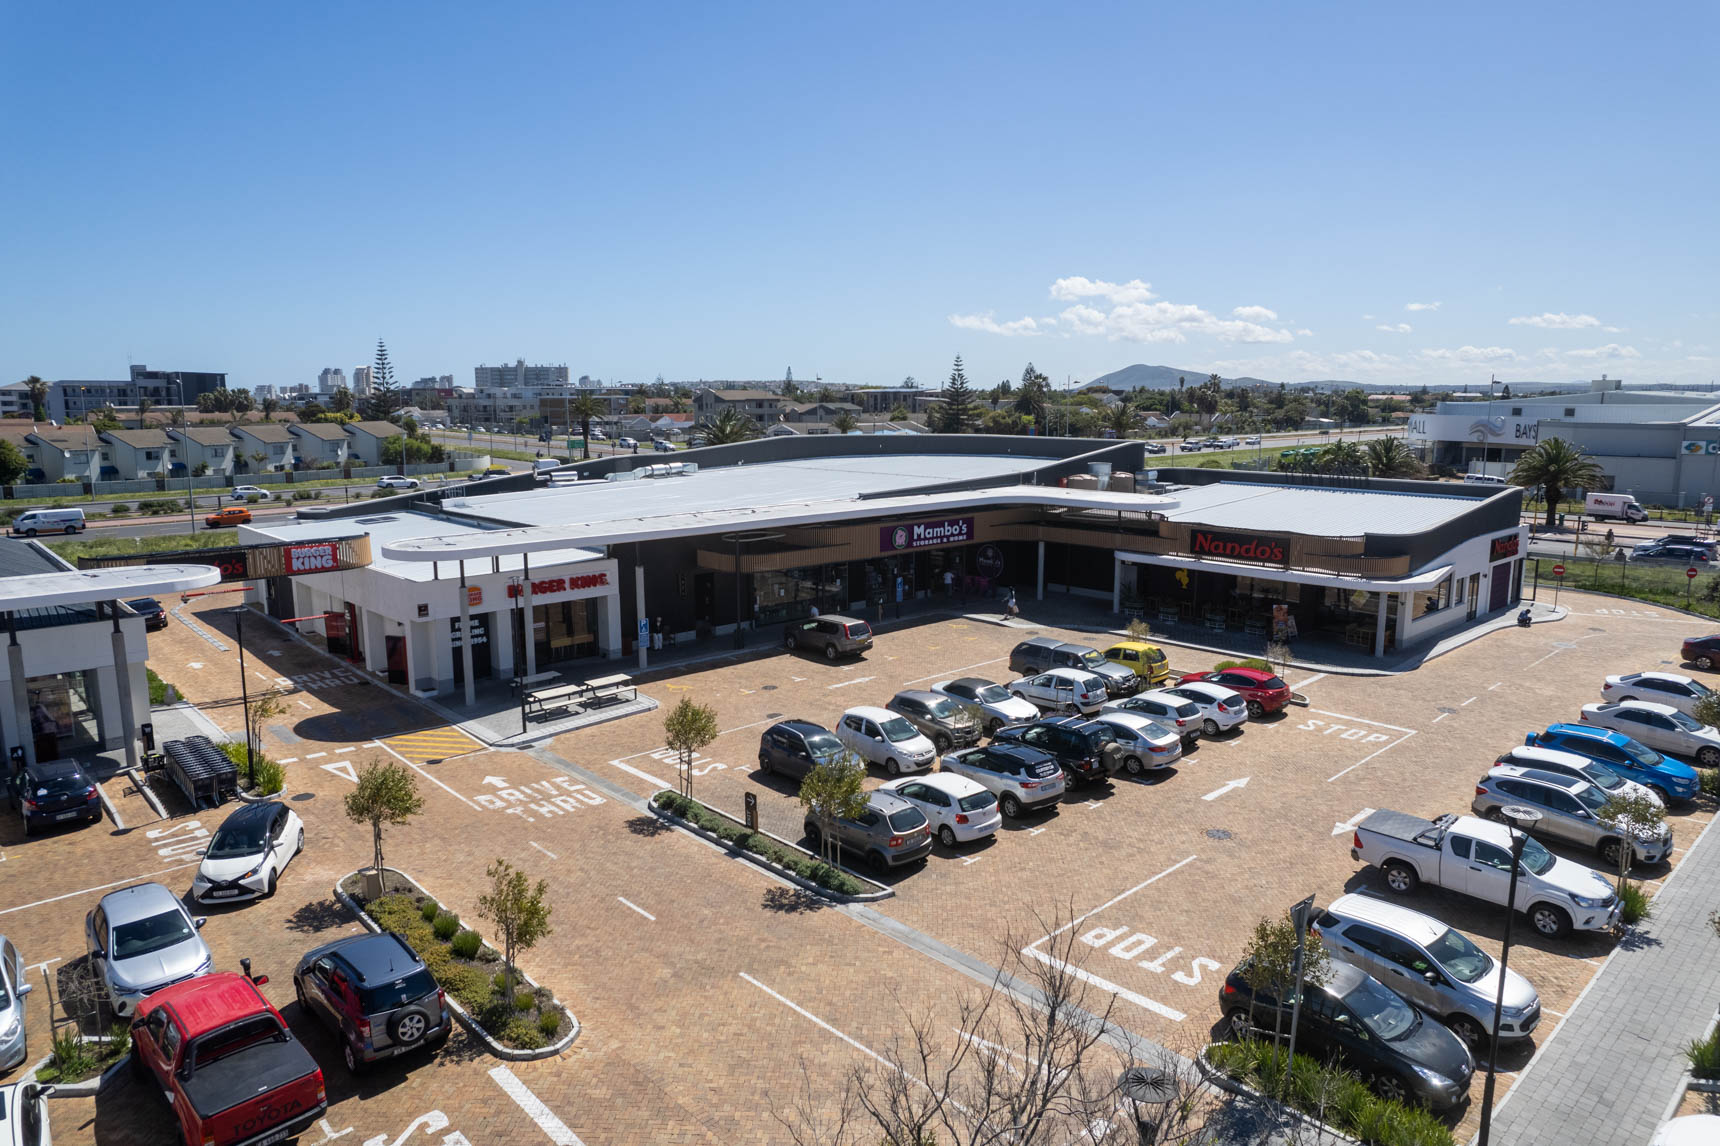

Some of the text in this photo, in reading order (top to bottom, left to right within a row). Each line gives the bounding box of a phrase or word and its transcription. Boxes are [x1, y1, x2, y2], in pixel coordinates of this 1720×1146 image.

[912, 538, 941, 547] STORAGE
[949, 534, 967, 543] HOME
[913, 519, 967, 540] Mambo's
[291, 546, 332, 558] BURGER
[1194, 532, 1283, 561] Nando's
[274, 668, 352, 685] DRIVE
[293, 676, 361, 690] THRU
[1295, 720, 1390, 743] STOP
[473, 776, 587, 809] DRIVE
[504, 790, 607, 822] THRU
[1079, 925, 1222, 986] STOP
[233, 1098, 302, 1137] TOYOTA
